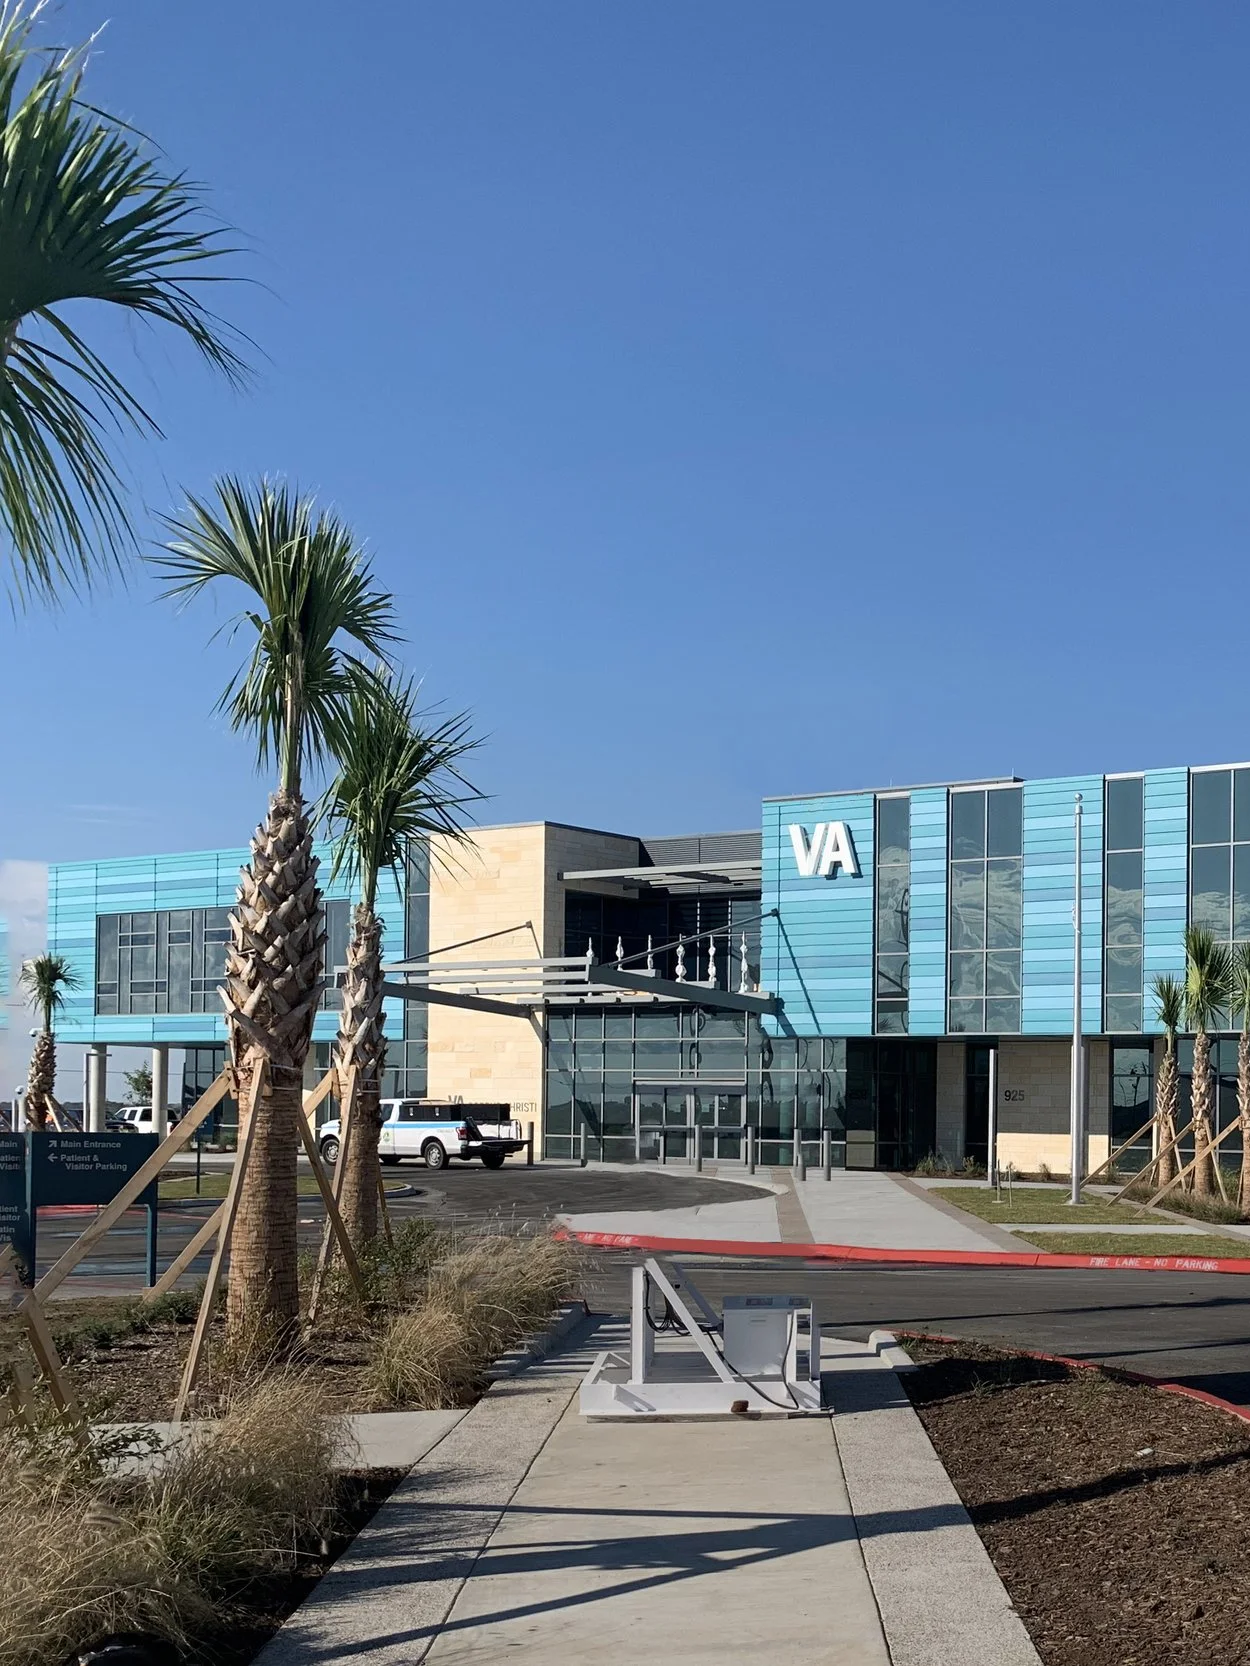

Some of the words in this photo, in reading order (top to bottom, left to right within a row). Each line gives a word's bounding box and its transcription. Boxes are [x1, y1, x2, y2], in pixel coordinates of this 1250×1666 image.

[788, 820, 860, 877] VA
[1004, 1089, 1024, 1101] 925
[510, 1102, 537, 1112] HRISTI
[60, 1140, 82, 1148] Main
[84, 1140, 121, 1148] Entrance
[60, 1154, 91, 1162] Patient
[92, 1154, 99, 1162] &
[65, 1163, 94, 1171] Visitor
[95, 1163, 128, 1172] Parking
[1089, 1257, 1109, 1266] FIRE
[1115, 1257, 1140, 1267] LANE
[1153, 1258, 1168, 1267] NO
[1175, 1259, 1219, 1270] PARKING
